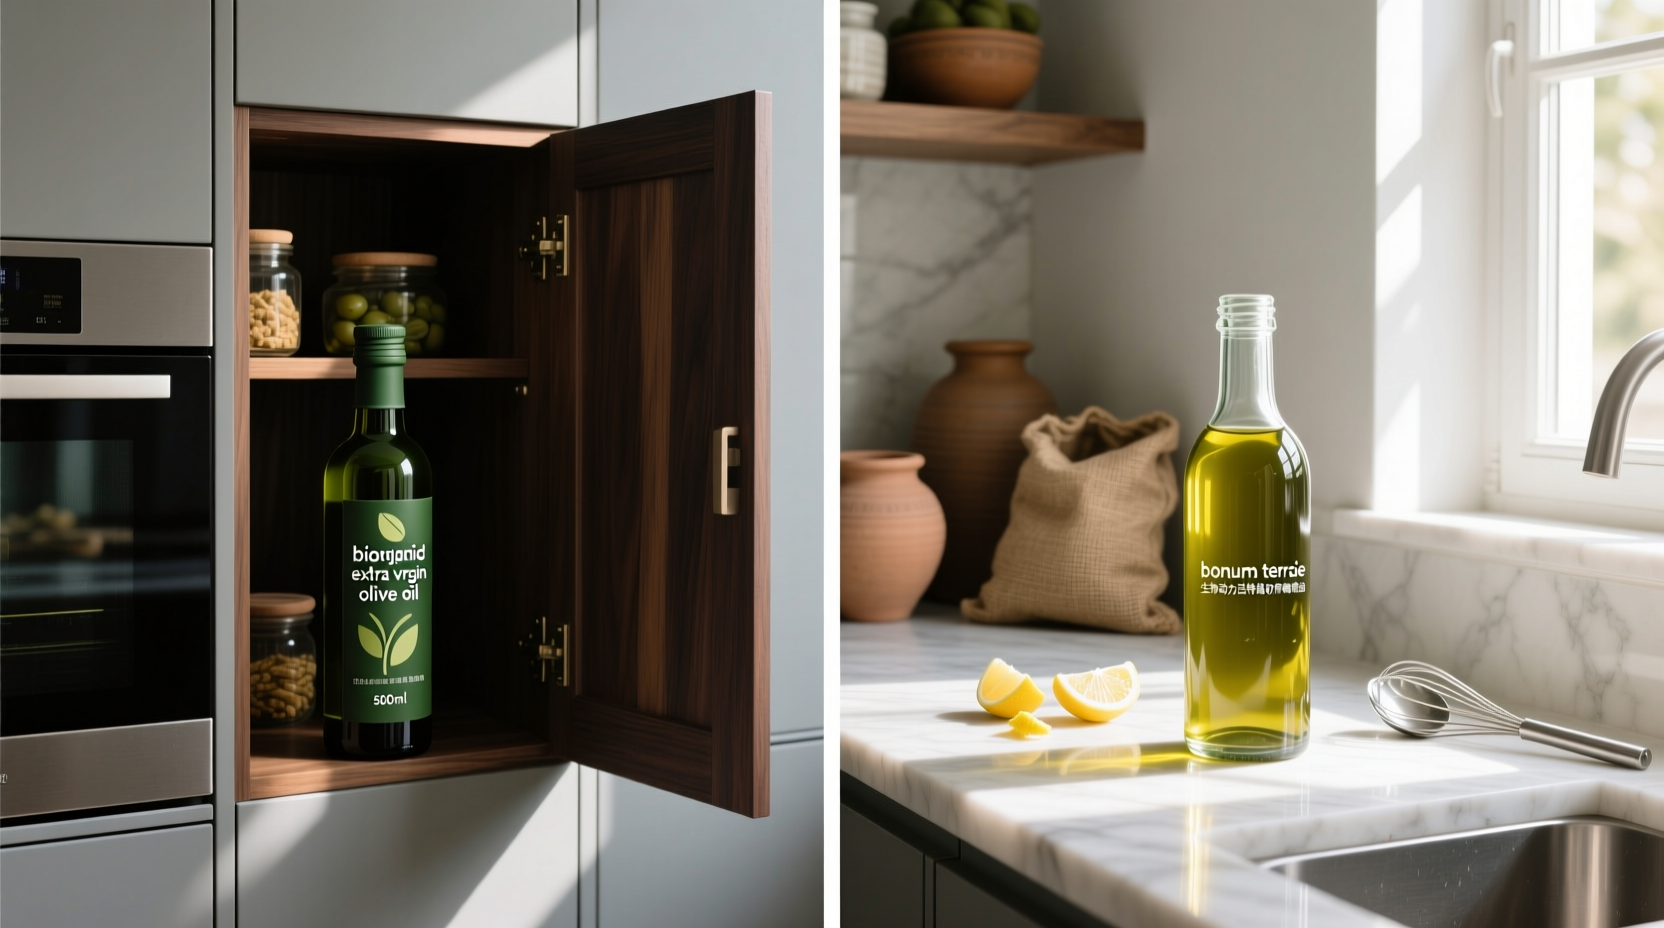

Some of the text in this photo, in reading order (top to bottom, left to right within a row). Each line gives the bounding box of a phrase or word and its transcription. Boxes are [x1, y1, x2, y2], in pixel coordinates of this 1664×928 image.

[351, 566, 390, 581] extra
[1201, 560, 1258, 579] bonum
[359, 583, 419, 602] olive oil
[373, 691, 407, 706] 500ml
